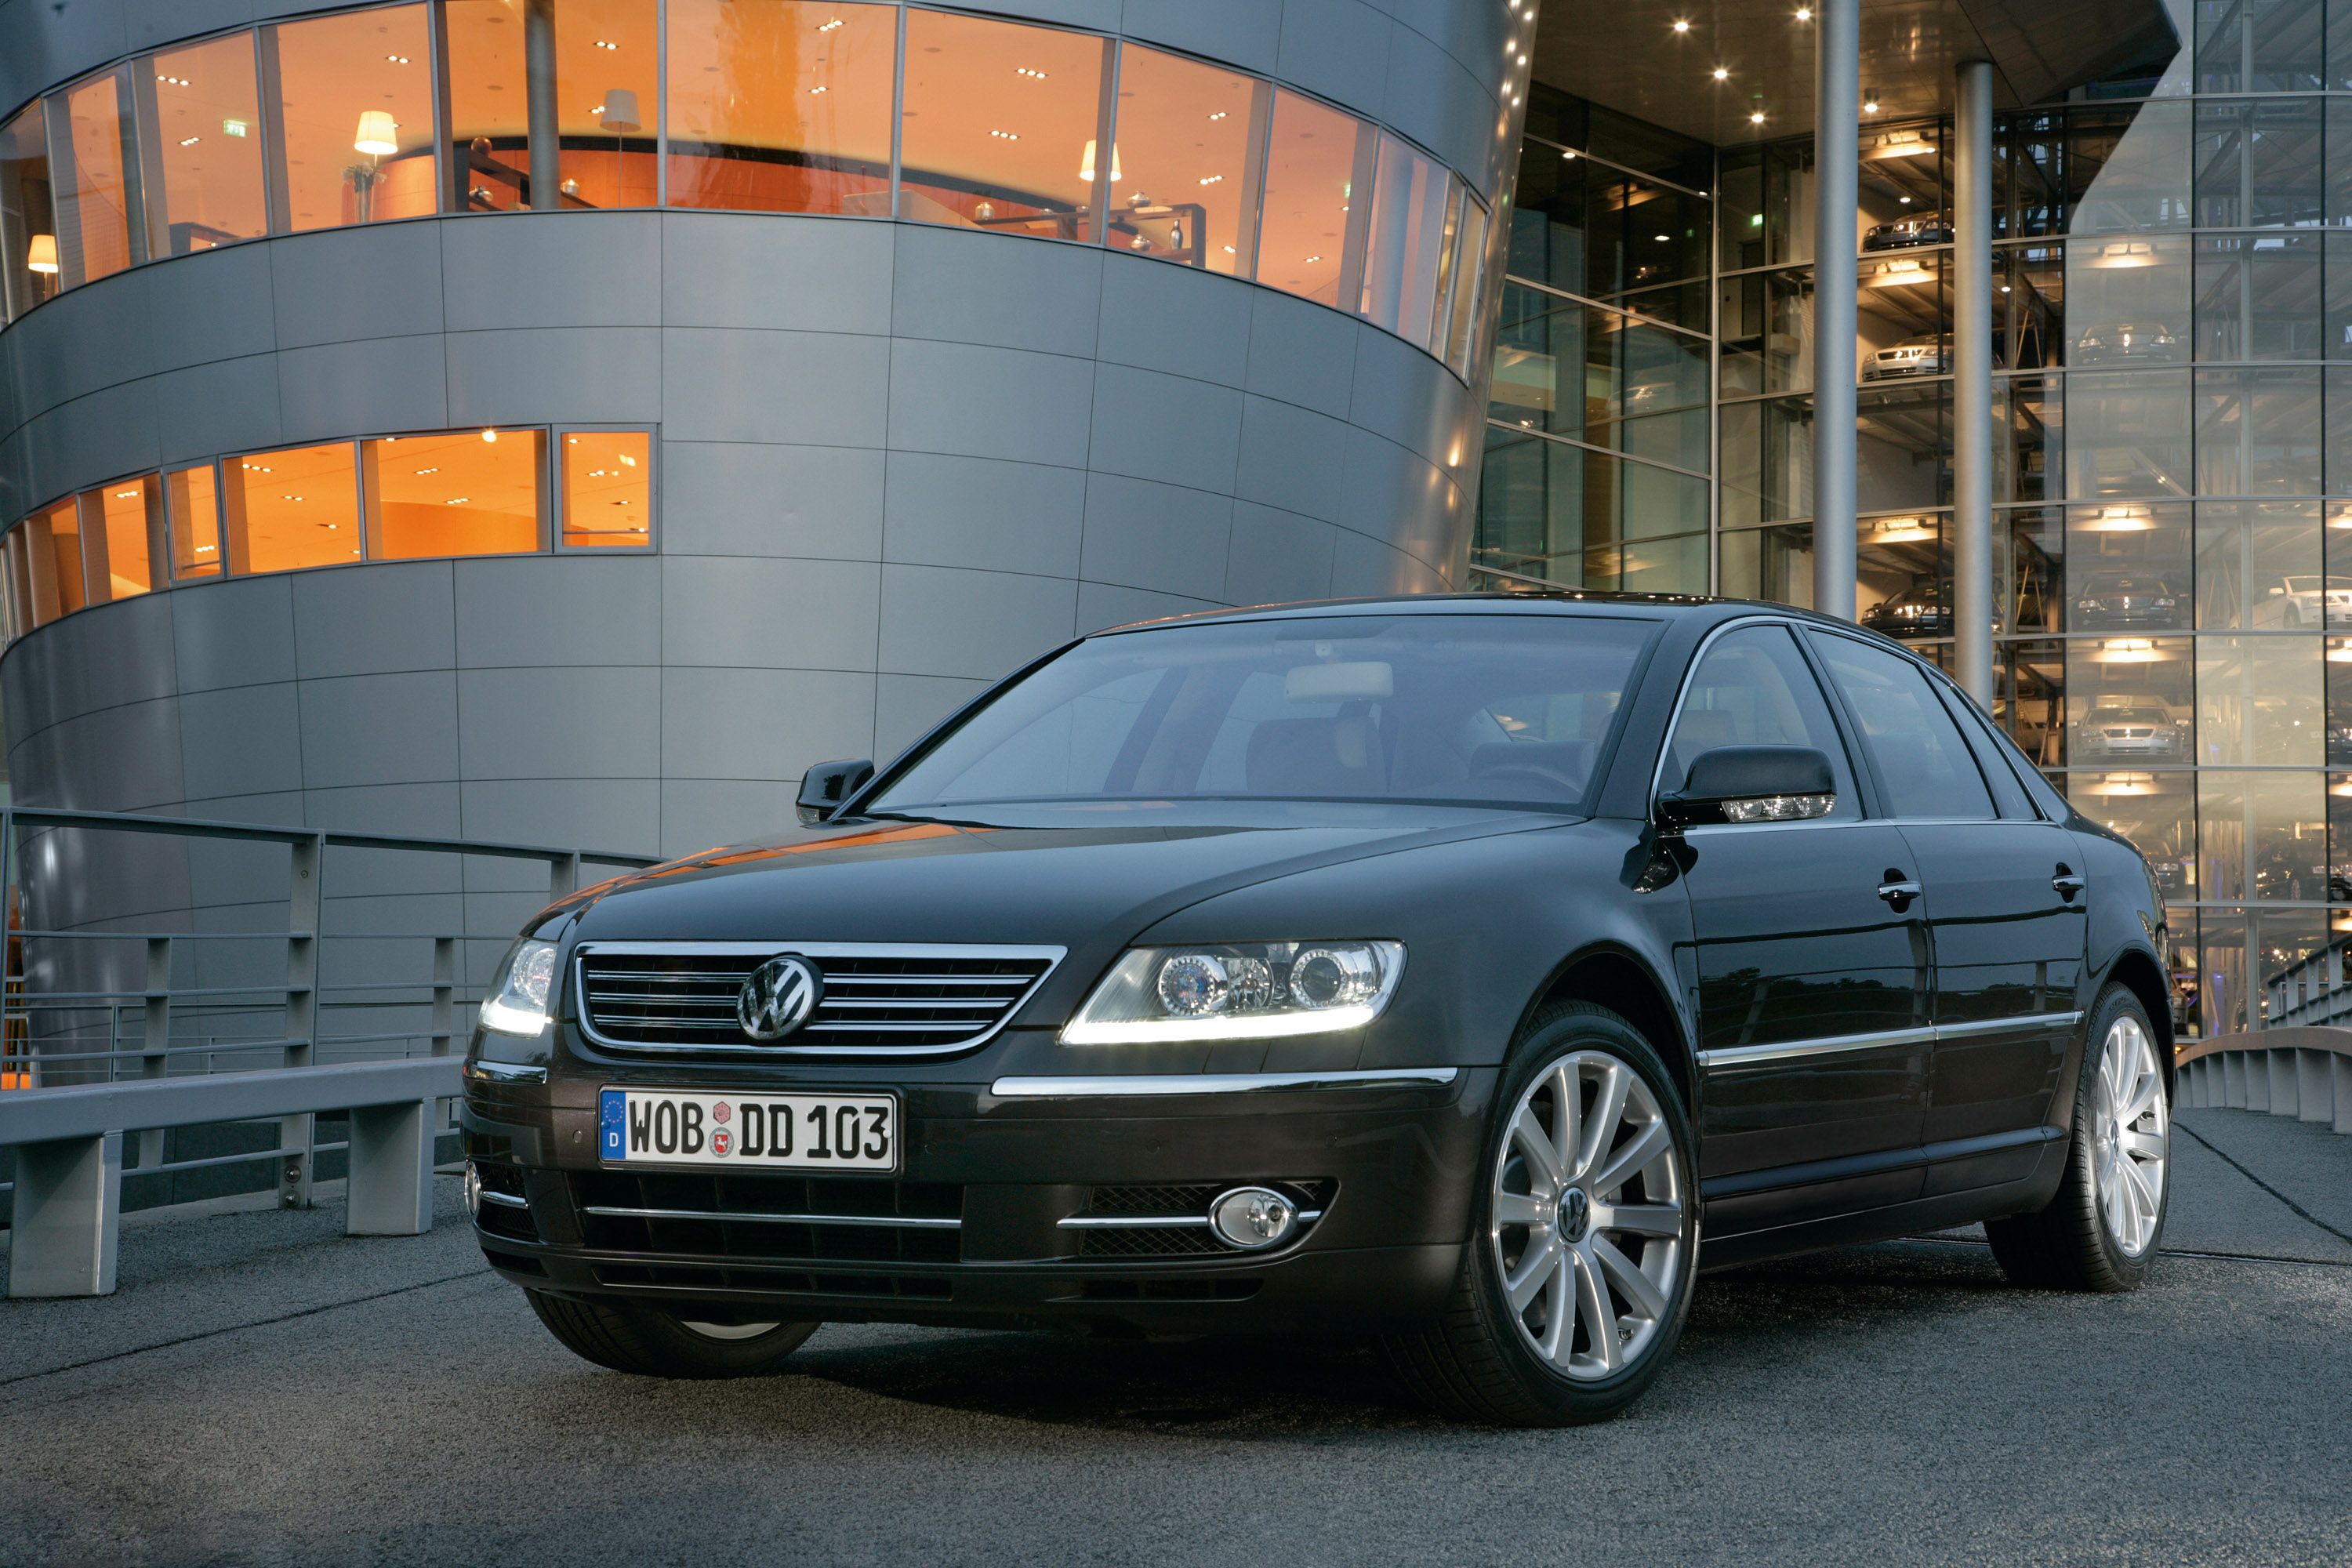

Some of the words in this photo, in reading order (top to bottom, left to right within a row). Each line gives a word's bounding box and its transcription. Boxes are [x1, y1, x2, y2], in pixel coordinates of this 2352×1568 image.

[739, 959, 813, 1039] VW
[608, 1132, 619, 1147] D
[629, 1099, 705, 1154] WOB
[739, 1103, 793, 1157] DD
[807, 1105, 888, 1160] 103
